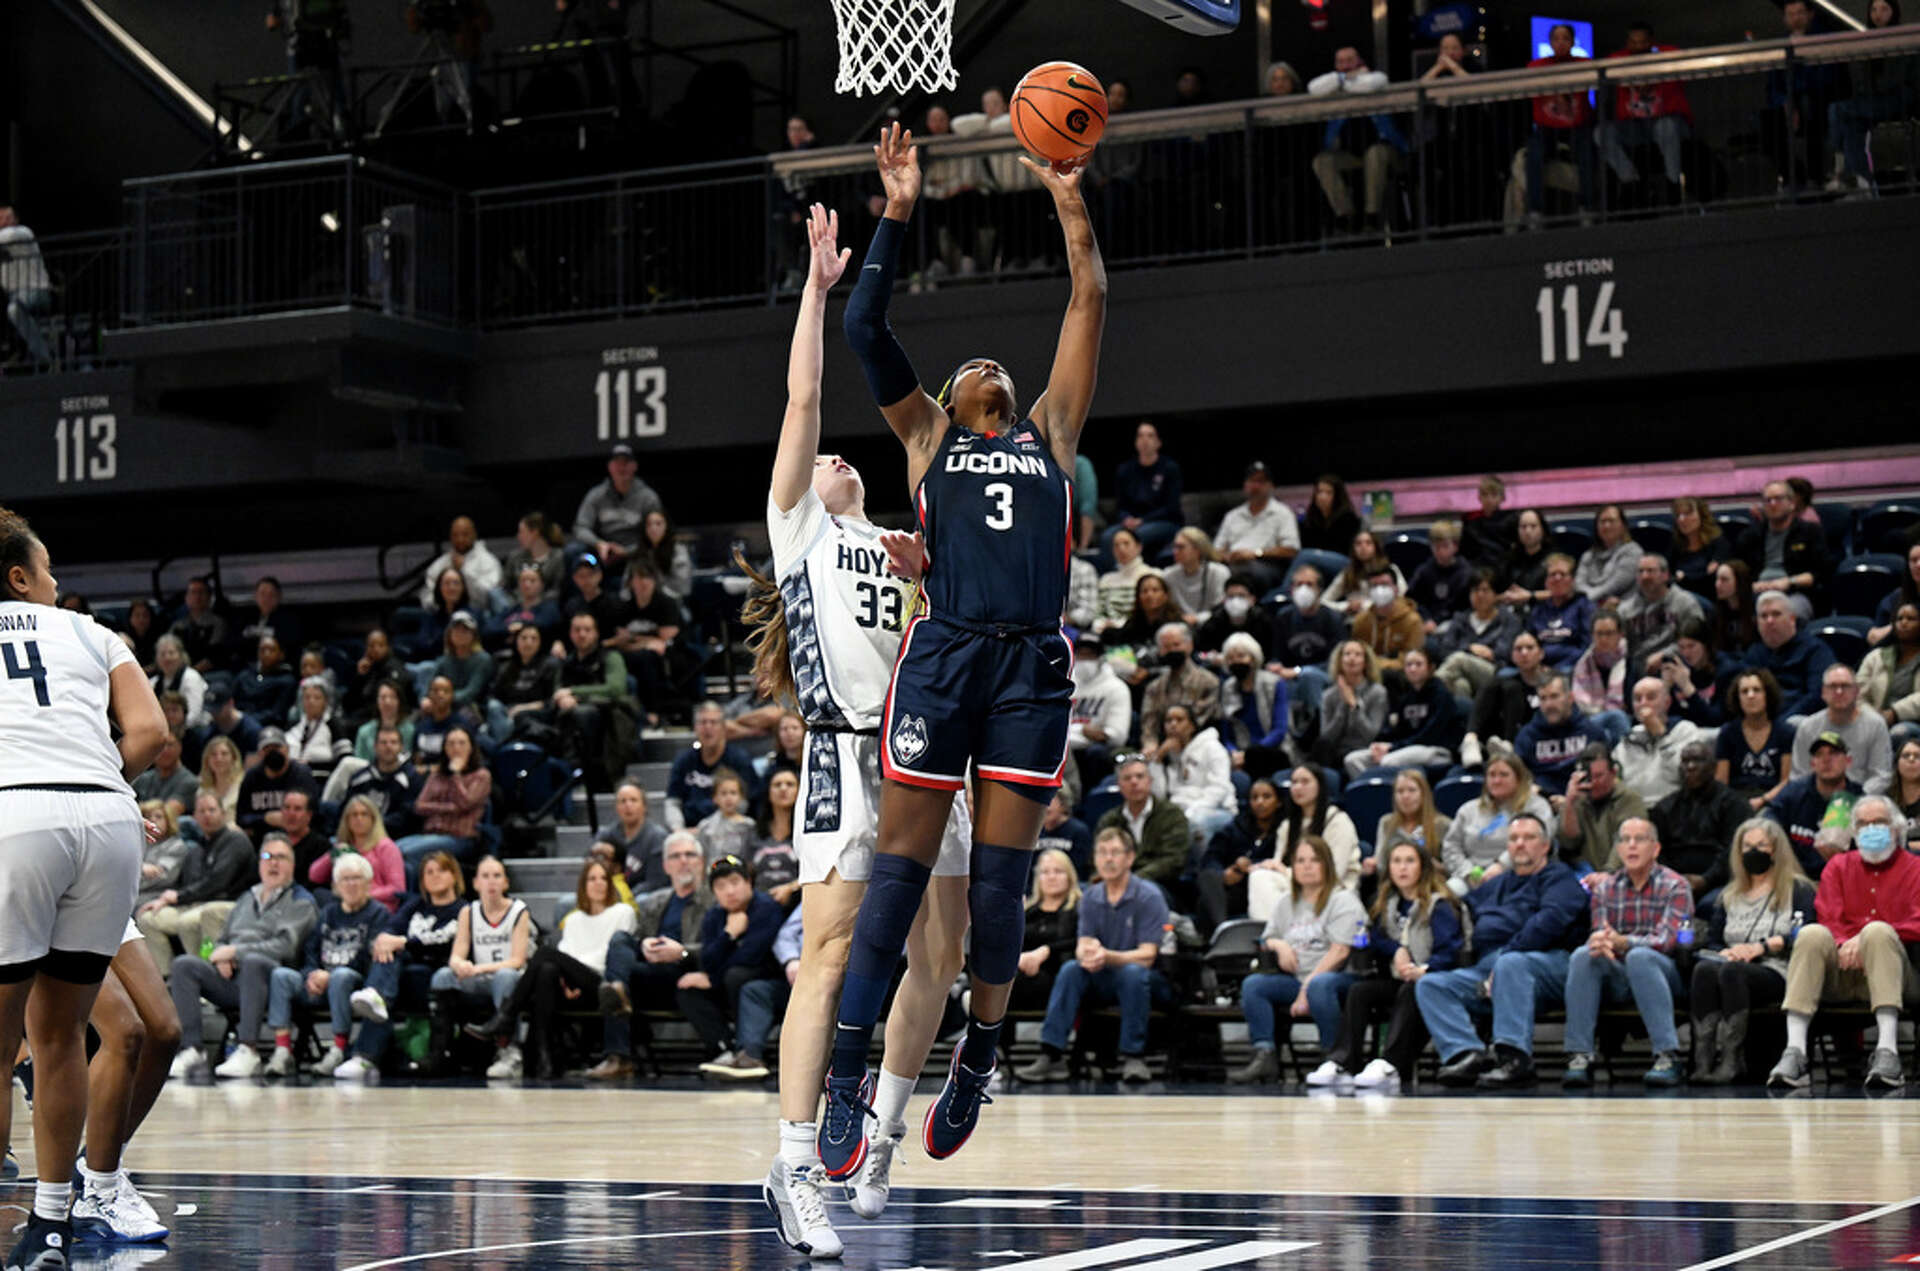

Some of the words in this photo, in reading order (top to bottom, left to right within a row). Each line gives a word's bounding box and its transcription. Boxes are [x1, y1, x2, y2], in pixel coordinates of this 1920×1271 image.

[1543, 258, 1613, 279] SECTION
[1536, 281, 1628, 364] 114
[602, 346, 658, 366] SECTION
[61, 395, 109, 413] SECTION
[595, 366, 666, 440] 113
[55, 414, 116, 482] 113
[945, 451, 1048, 478] UCONN
[984, 482, 1013, 531] 3
[836, 543, 910, 584] HOY
[855, 581, 902, 632] 33
[0, 640, 51, 707] 4
